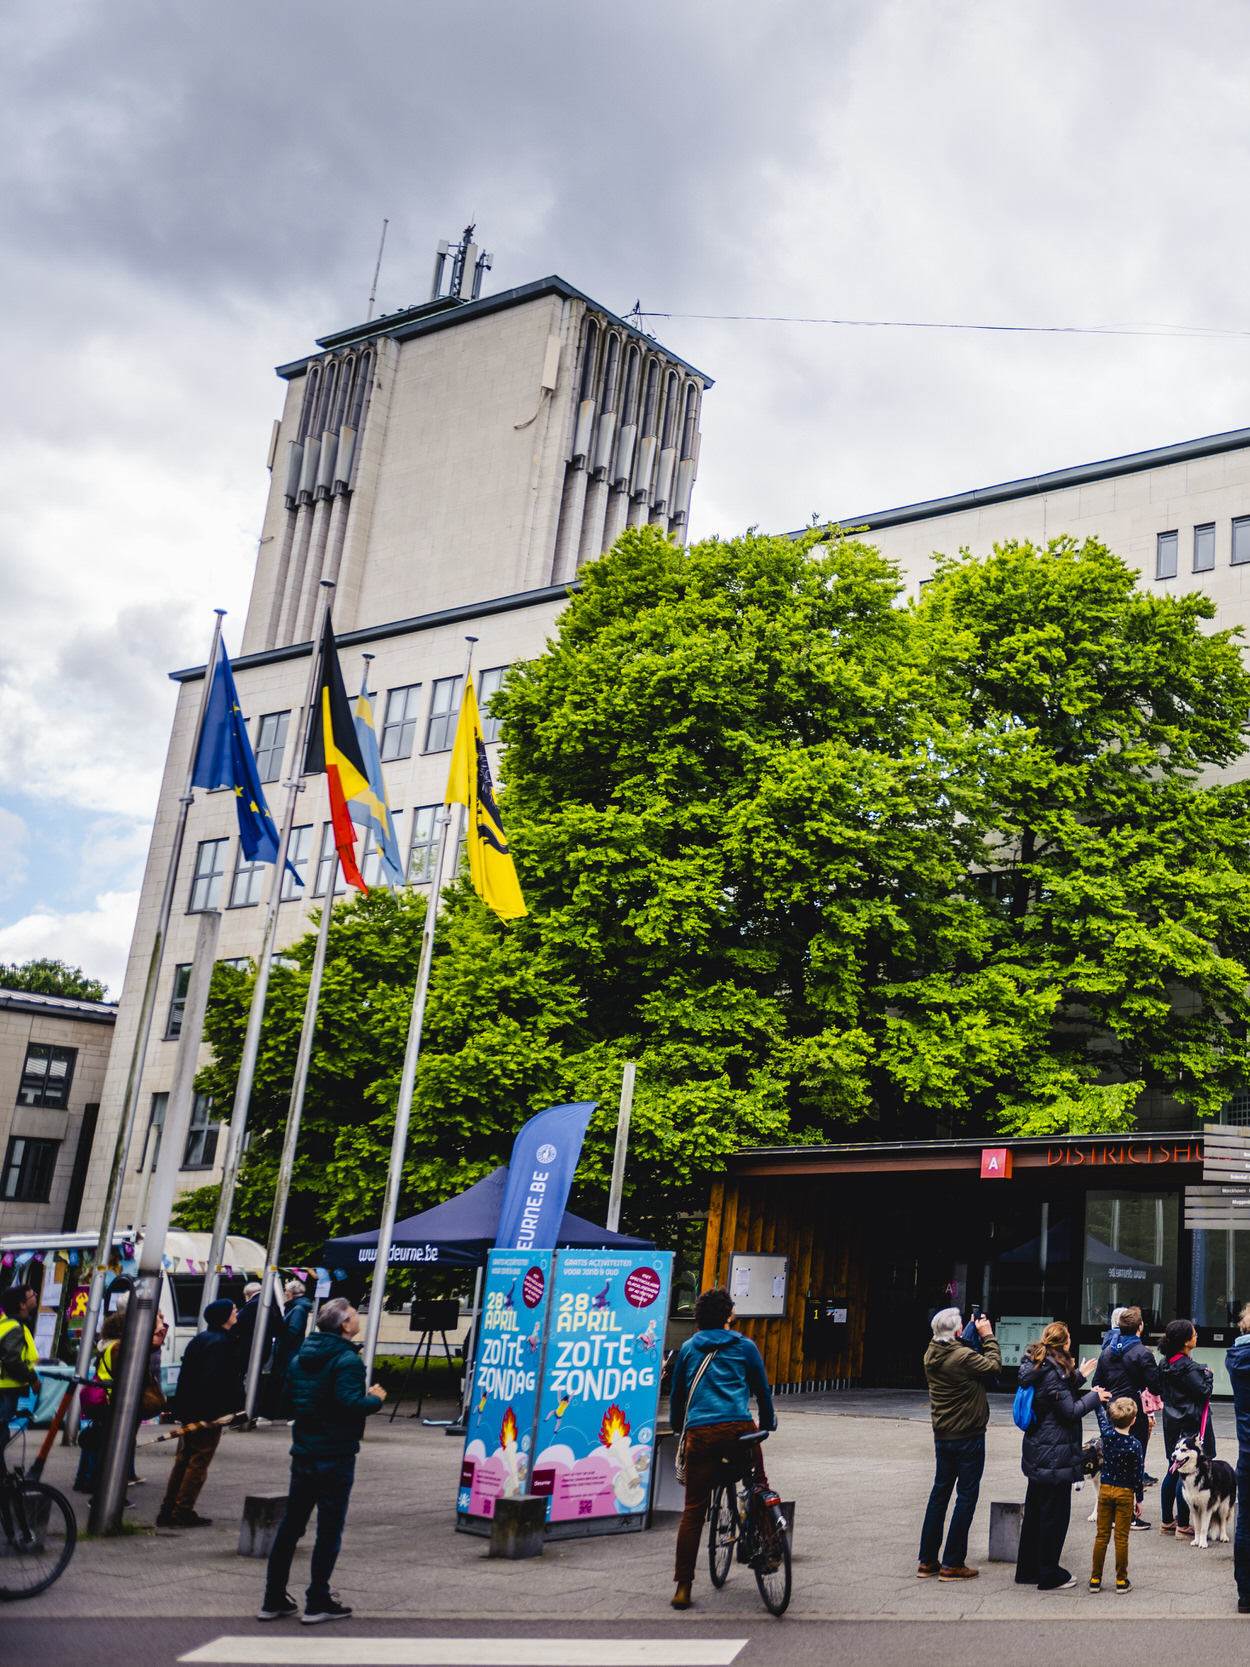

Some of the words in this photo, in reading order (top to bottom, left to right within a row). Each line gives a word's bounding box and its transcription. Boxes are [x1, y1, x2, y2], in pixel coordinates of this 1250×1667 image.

[988, 1157, 998, 1170] A
[1048, 1143, 1204, 1165] DISTRICTSHU
[516, 1171, 549, 1250] EURNE.BE
[358, 1244, 439, 1262] wwdeurne.be
[487, 1292, 504, 1310] 28
[560, 1293, 589, 1312] 28
[484, 1310, 520, 1331] APRIL
[557, 1311, 622, 1332] APRIL
[482, 1334, 526, 1367] ZOTTE
[555, 1334, 634, 1368] ZOTTE
[478, 1366, 535, 1402] ZONDAG
[550, 1367, 654, 1401] ZONDAG
